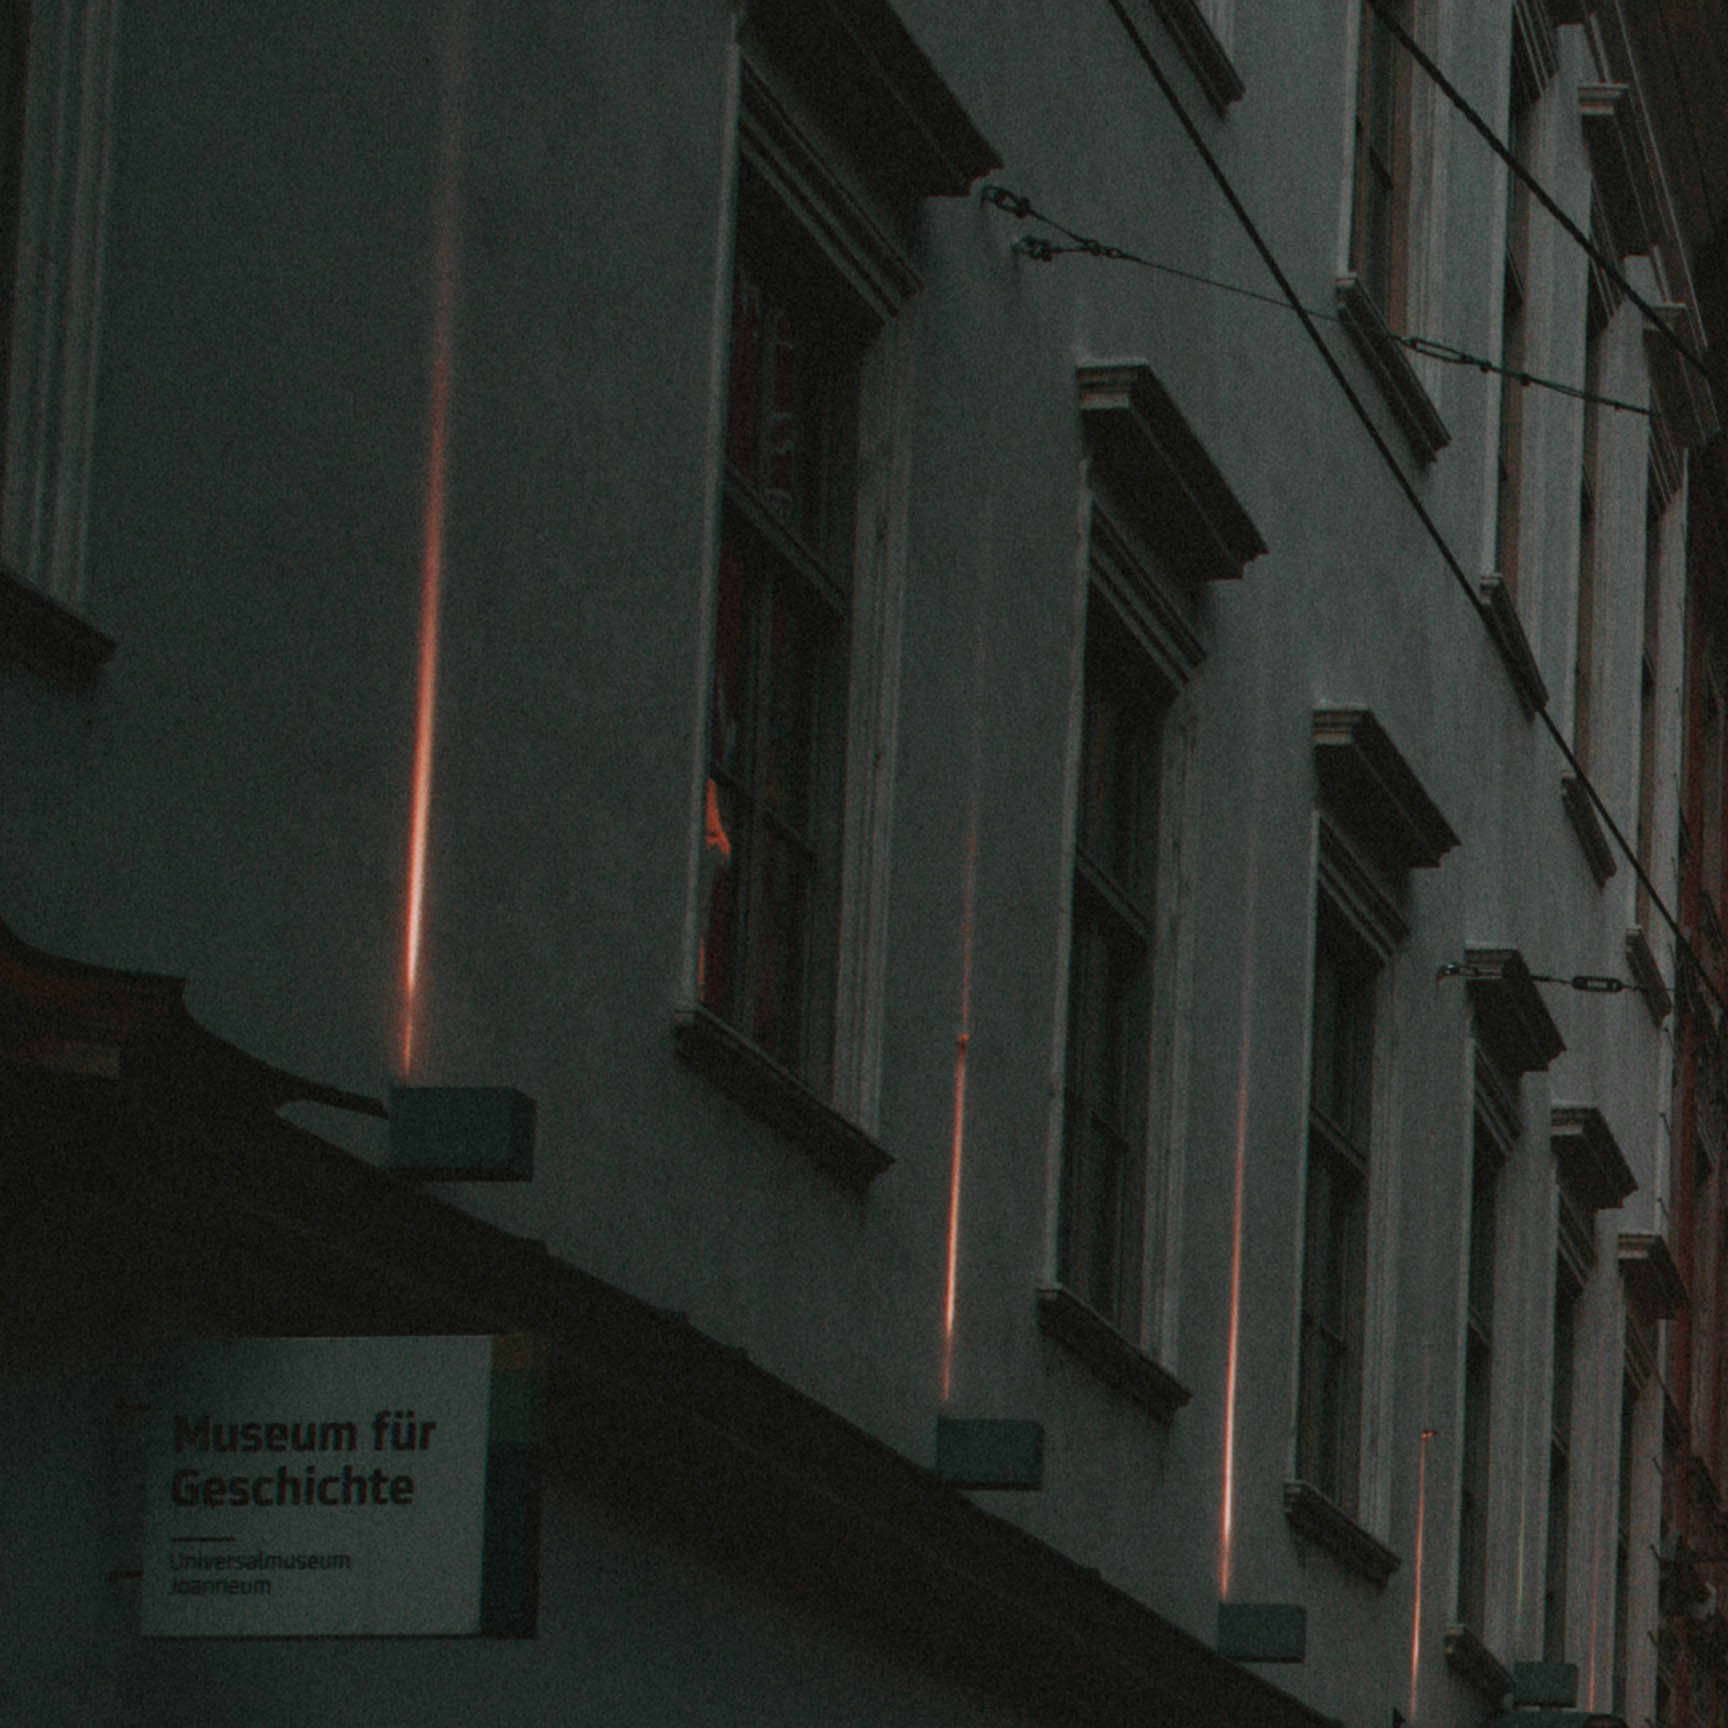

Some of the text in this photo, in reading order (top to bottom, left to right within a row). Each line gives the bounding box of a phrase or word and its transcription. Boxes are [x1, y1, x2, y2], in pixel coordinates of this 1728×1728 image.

[173, 1410, 437, 1452] Museum für
[171, 1465, 415, 1507] Geschichte
[169, 1552, 351, 1571] Universalmuseum
[168, 1578, 272, 1596] Joanneum
